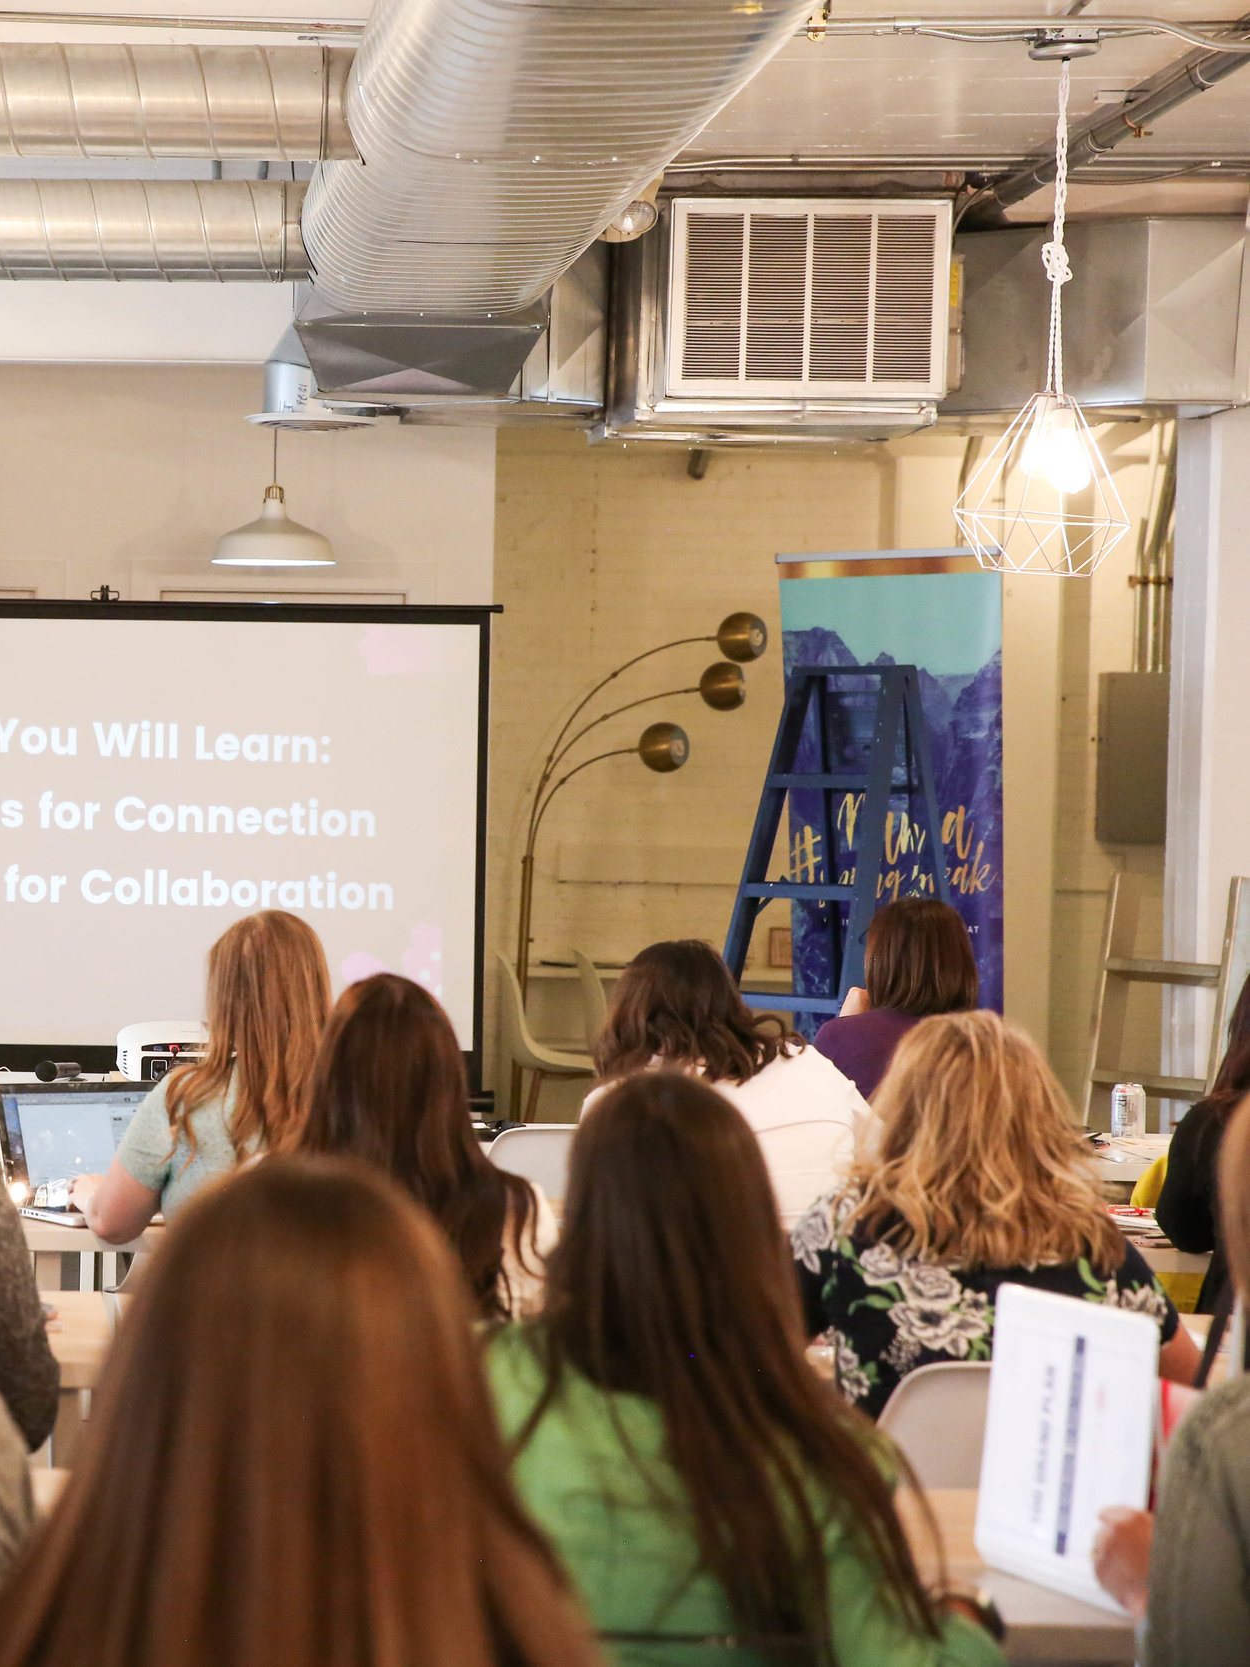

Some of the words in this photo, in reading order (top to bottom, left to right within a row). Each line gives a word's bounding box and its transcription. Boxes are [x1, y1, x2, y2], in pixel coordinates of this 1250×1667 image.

[92, 719, 179, 760] Will
[196, 725, 332, 764] Learn:
[38, 790, 101, 831] for
[114, 796, 377, 838] Connection
[4, 863, 67, 904] for
[80, 868, 395, 911] Collaboration
